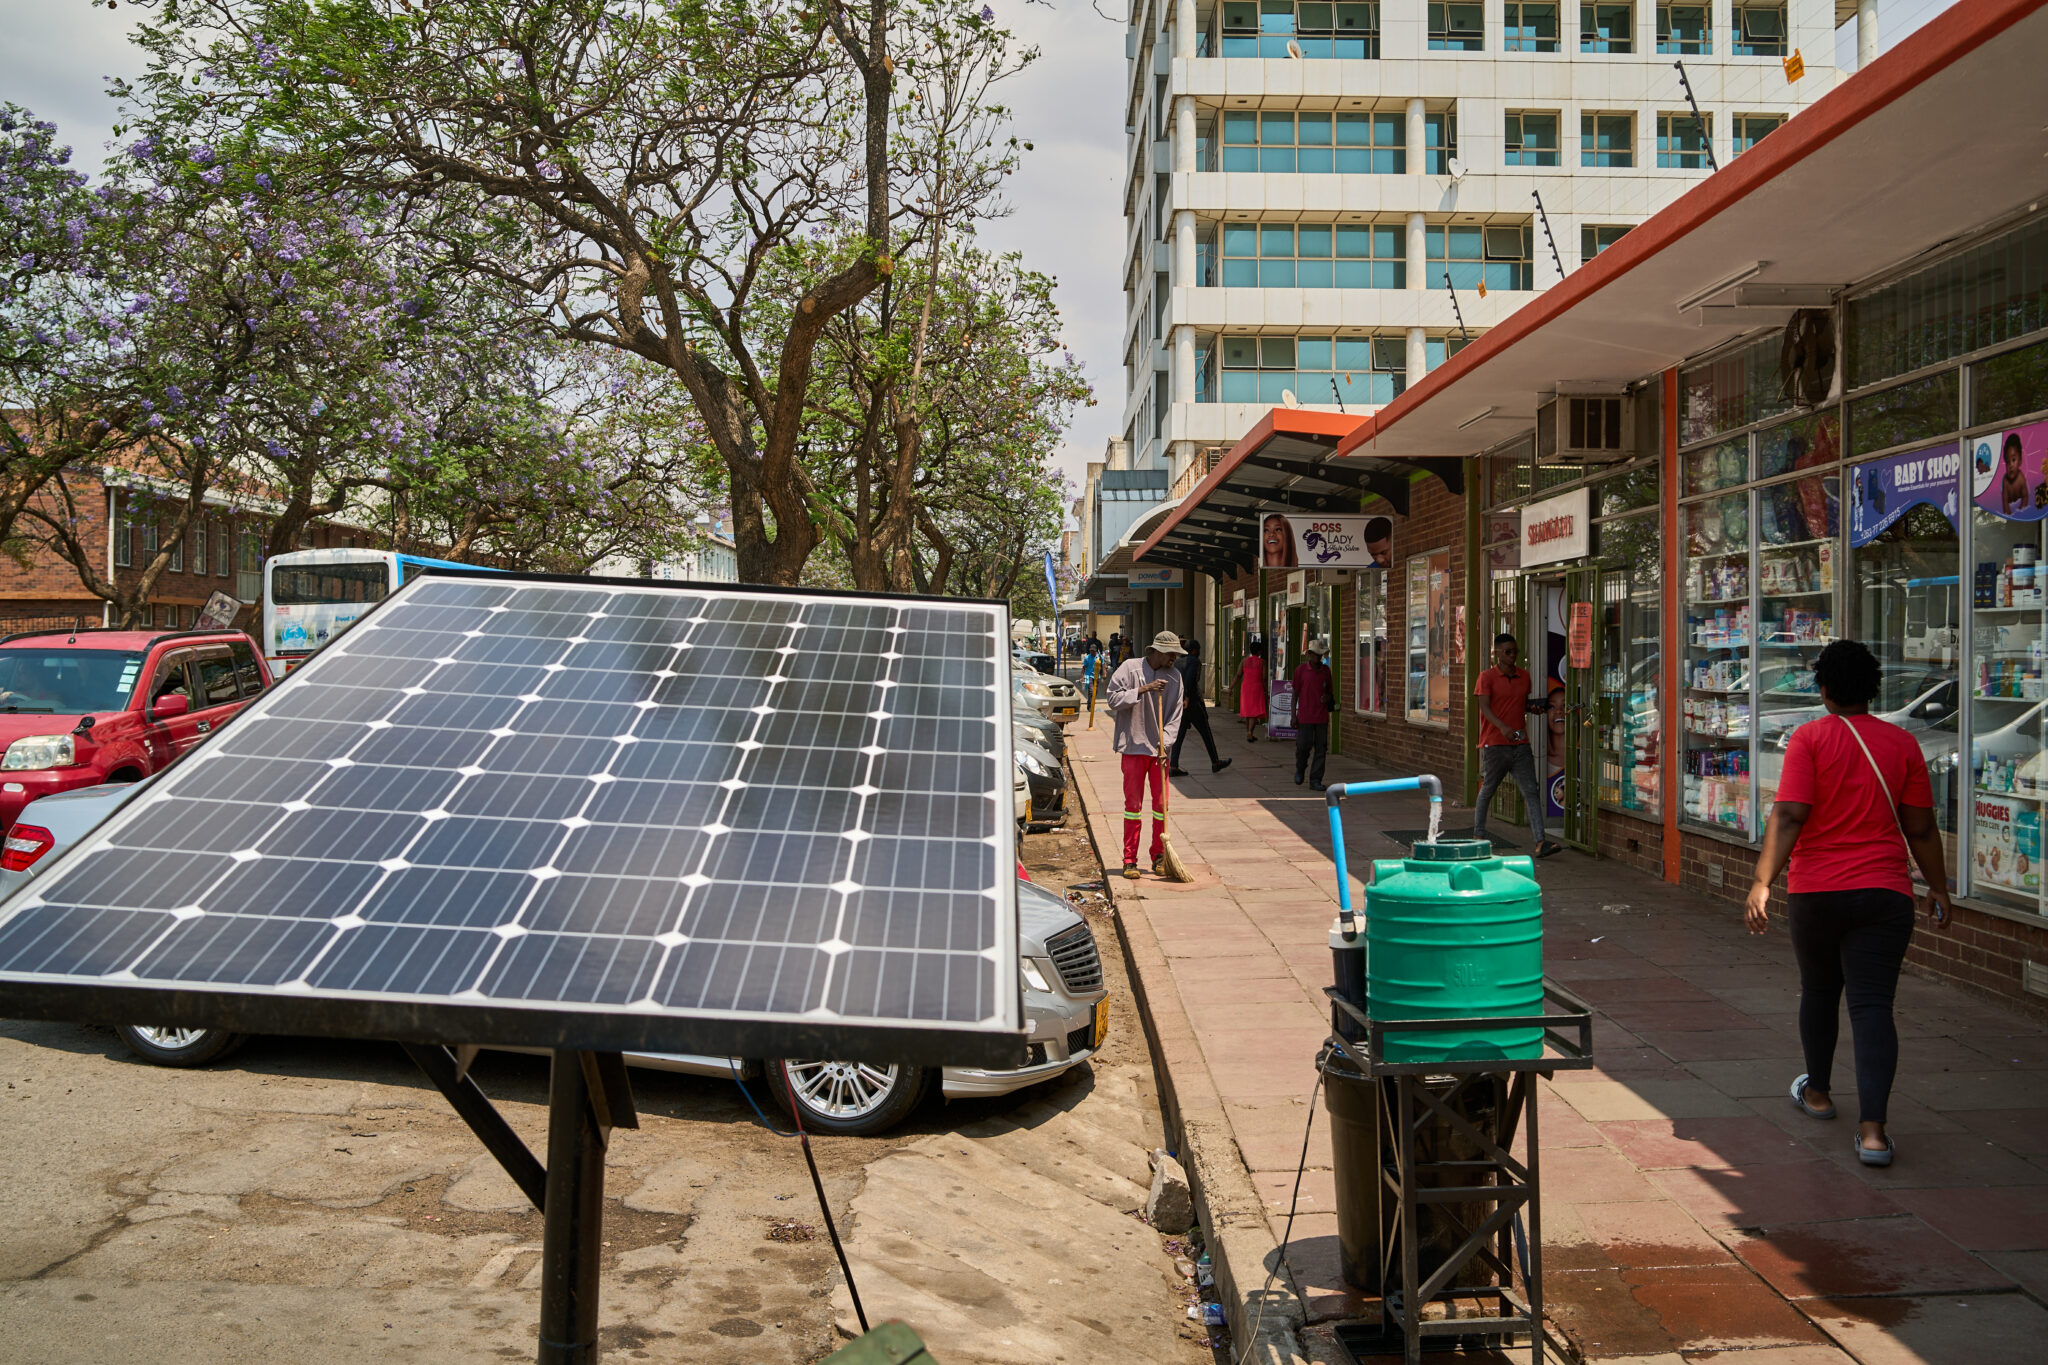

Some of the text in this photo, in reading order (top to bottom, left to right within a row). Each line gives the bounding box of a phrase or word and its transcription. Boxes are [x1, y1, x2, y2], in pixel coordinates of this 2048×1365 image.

[1894, 453, 1960, 487] BABY SHOP
[1312, 522, 1342, 533] BOSS
[1327, 529, 1353, 544] LADY
[1342, 543, 1360, 553] Salon
[1975, 800, 2010, 822] HUGGIES
[1988, 821, 2000, 830] care
